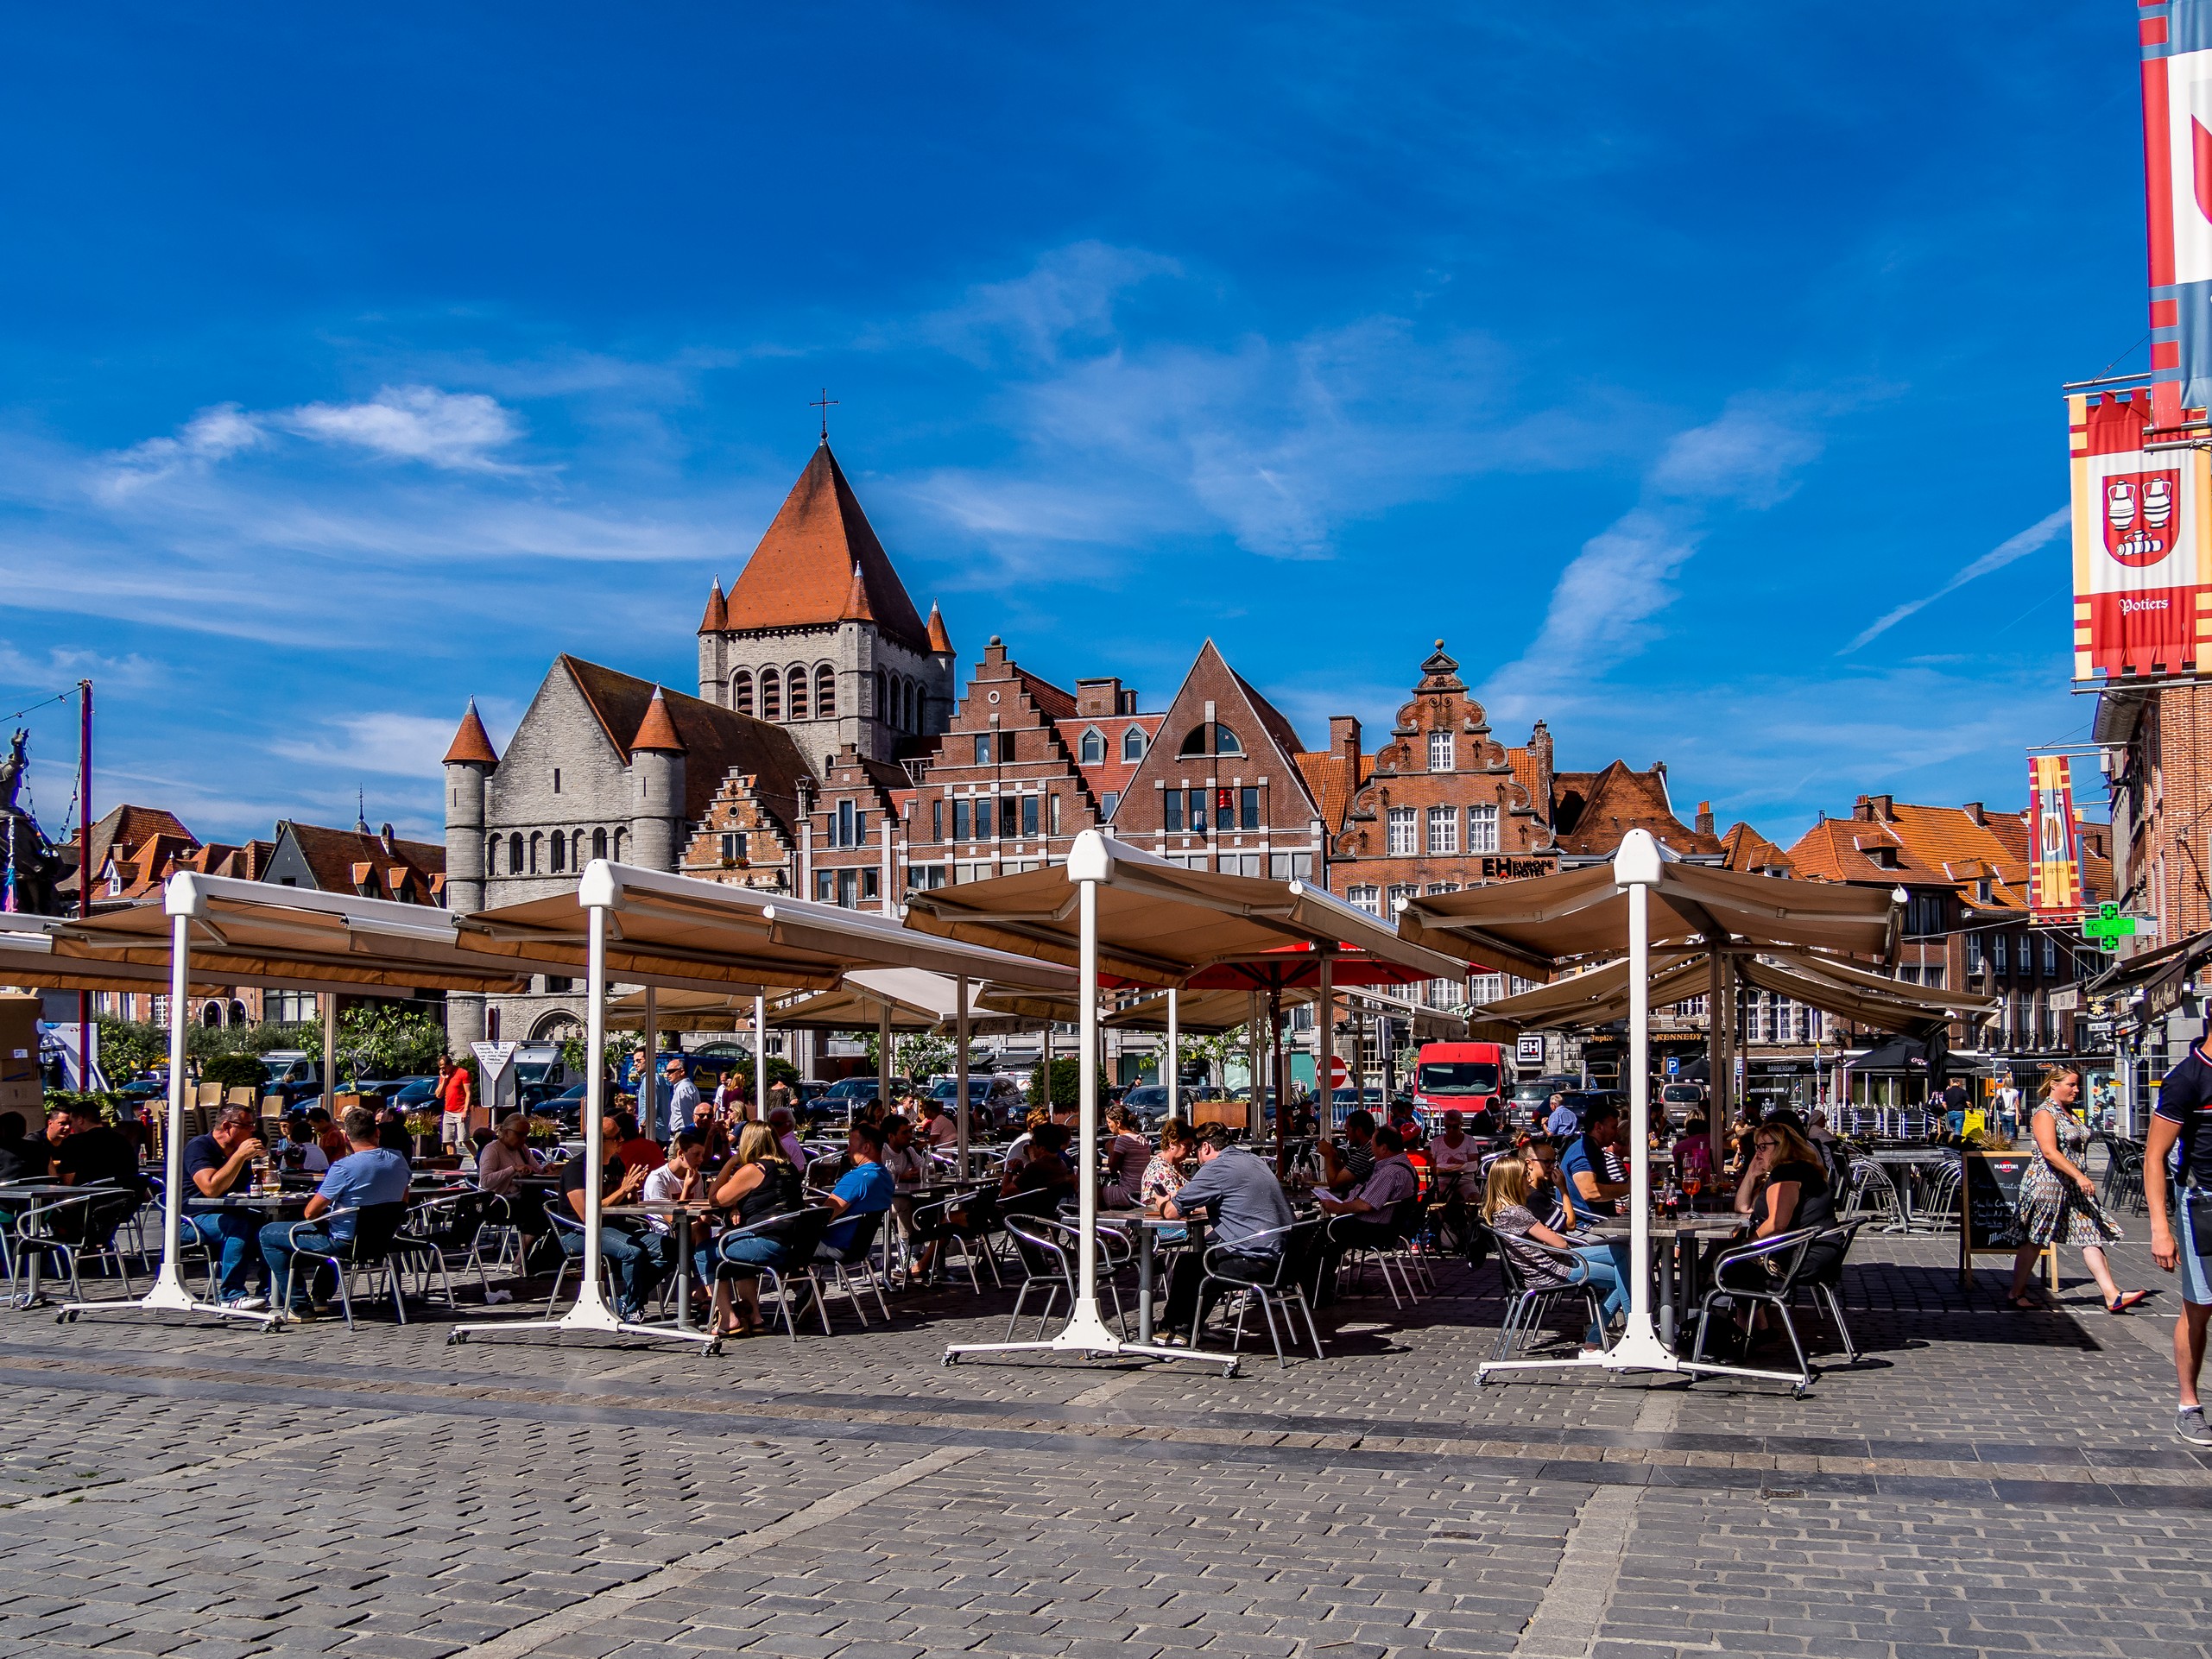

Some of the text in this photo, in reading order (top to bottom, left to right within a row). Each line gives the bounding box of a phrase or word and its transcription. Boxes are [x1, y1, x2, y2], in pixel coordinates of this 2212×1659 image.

[2118, 597, 2169, 615] Potiers
[1482, 857, 1512, 876] EH
[1520, 1041, 1539, 1053] EH
